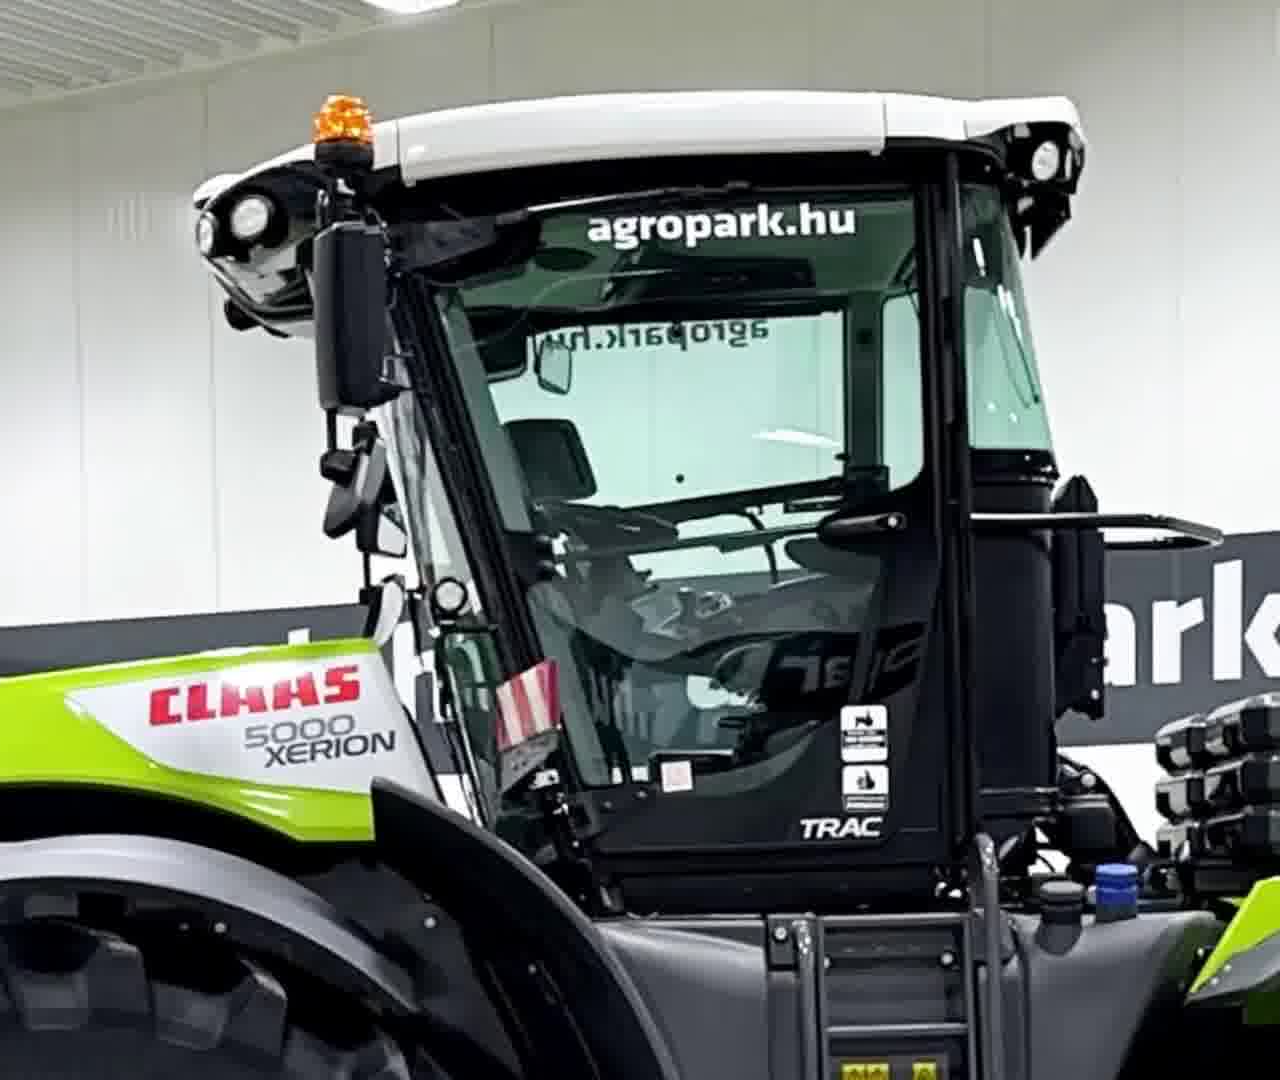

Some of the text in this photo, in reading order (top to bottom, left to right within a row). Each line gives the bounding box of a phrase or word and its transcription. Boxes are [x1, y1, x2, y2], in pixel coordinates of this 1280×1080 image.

[587, 203, 855, 250] agropark.hu
[149, 664, 361, 726] CLAAS
[244, 714, 356, 749] 5000
[264, 731, 396, 768] XERION
[800, 816, 883, 840] TRAC
